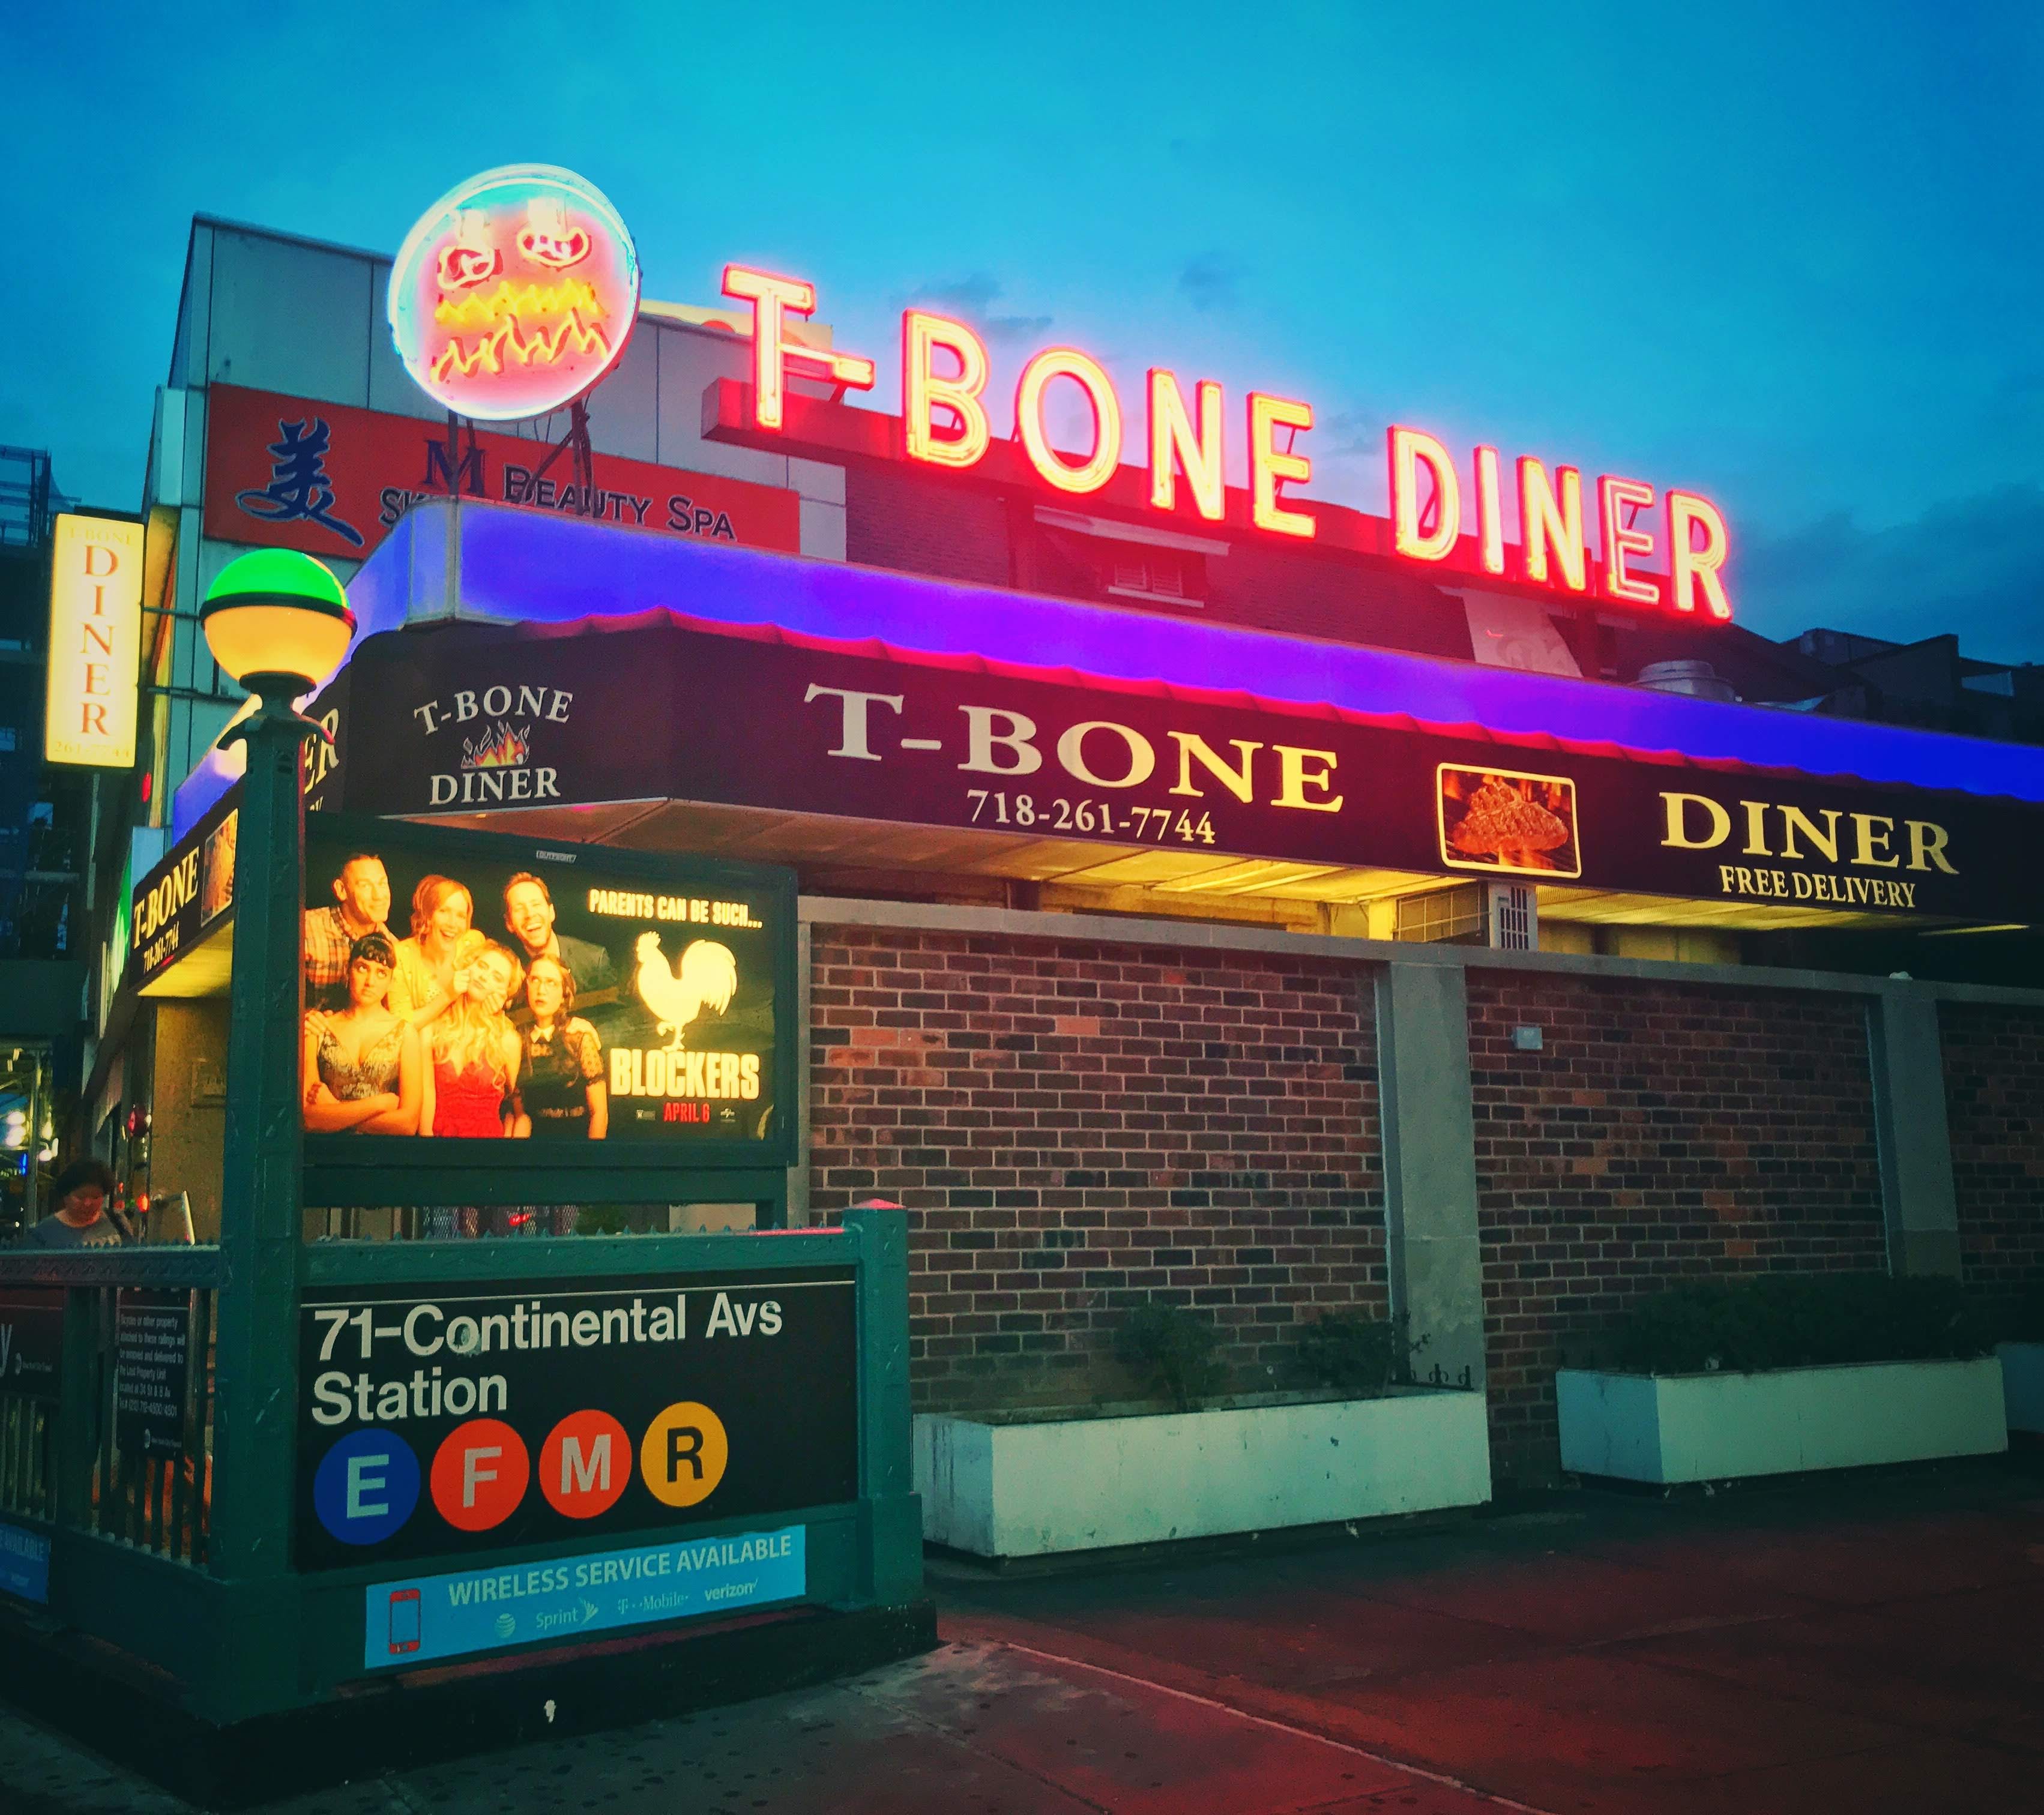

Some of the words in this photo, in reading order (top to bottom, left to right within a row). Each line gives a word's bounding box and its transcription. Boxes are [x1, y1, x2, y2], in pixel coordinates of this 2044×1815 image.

[722, 263, 1316, 538] T-BONE
[235, 417, 365, 547] 美
[504, 465, 653, 523] BEAUTY
[666, 495, 737, 541] SPA
[1387, 423, 1731, 621] DINER
[80, 544, 118, 736] DINER
[414, 685, 573, 735] T-BONE
[804, 682, 1344, 813] T-BONE
[429, 767, 561, 805] DINER
[967, 789, 1216, 844] 718-261-7744
[1659, 791, 1960, 875] DINER
[134, 846, 199, 950] T-BONE
[589, 888, 654, 918] PARENTS
[657, 895, 687, 921] CAN
[690, 898, 710, 924] BE
[713, 901, 764, 929] SUCH...
[1719, 865, 1790, 898] FREE
[1793, 871, 1916, 908] DELIVERY
[609, 1047, 760, 1100] BLOCKERS
[663, 1102, 699, 1123] APRIL
[701, 1103, 711, 1124] 6
[314, 1295, 686, 1362] 71-Continental
[705, 1291, 783, 1338] Avs
[310, 1367, 508, 1426] Station
[346, 1453, 390, 1519] E
[462, 1445, 503, 1508] F
[561, 1433, 612, 1496] M
[666, 1425, 705, 1484] R
[448, 1567, 569, 1607] WIRELESS
[574, 1552, 671, 1588] SERVICE
[676, 1535, 792, 1573] AVAILABLE
[705, 1584, 756, 1602] verizon
[535, 1607, 579, 1630] Sprint
